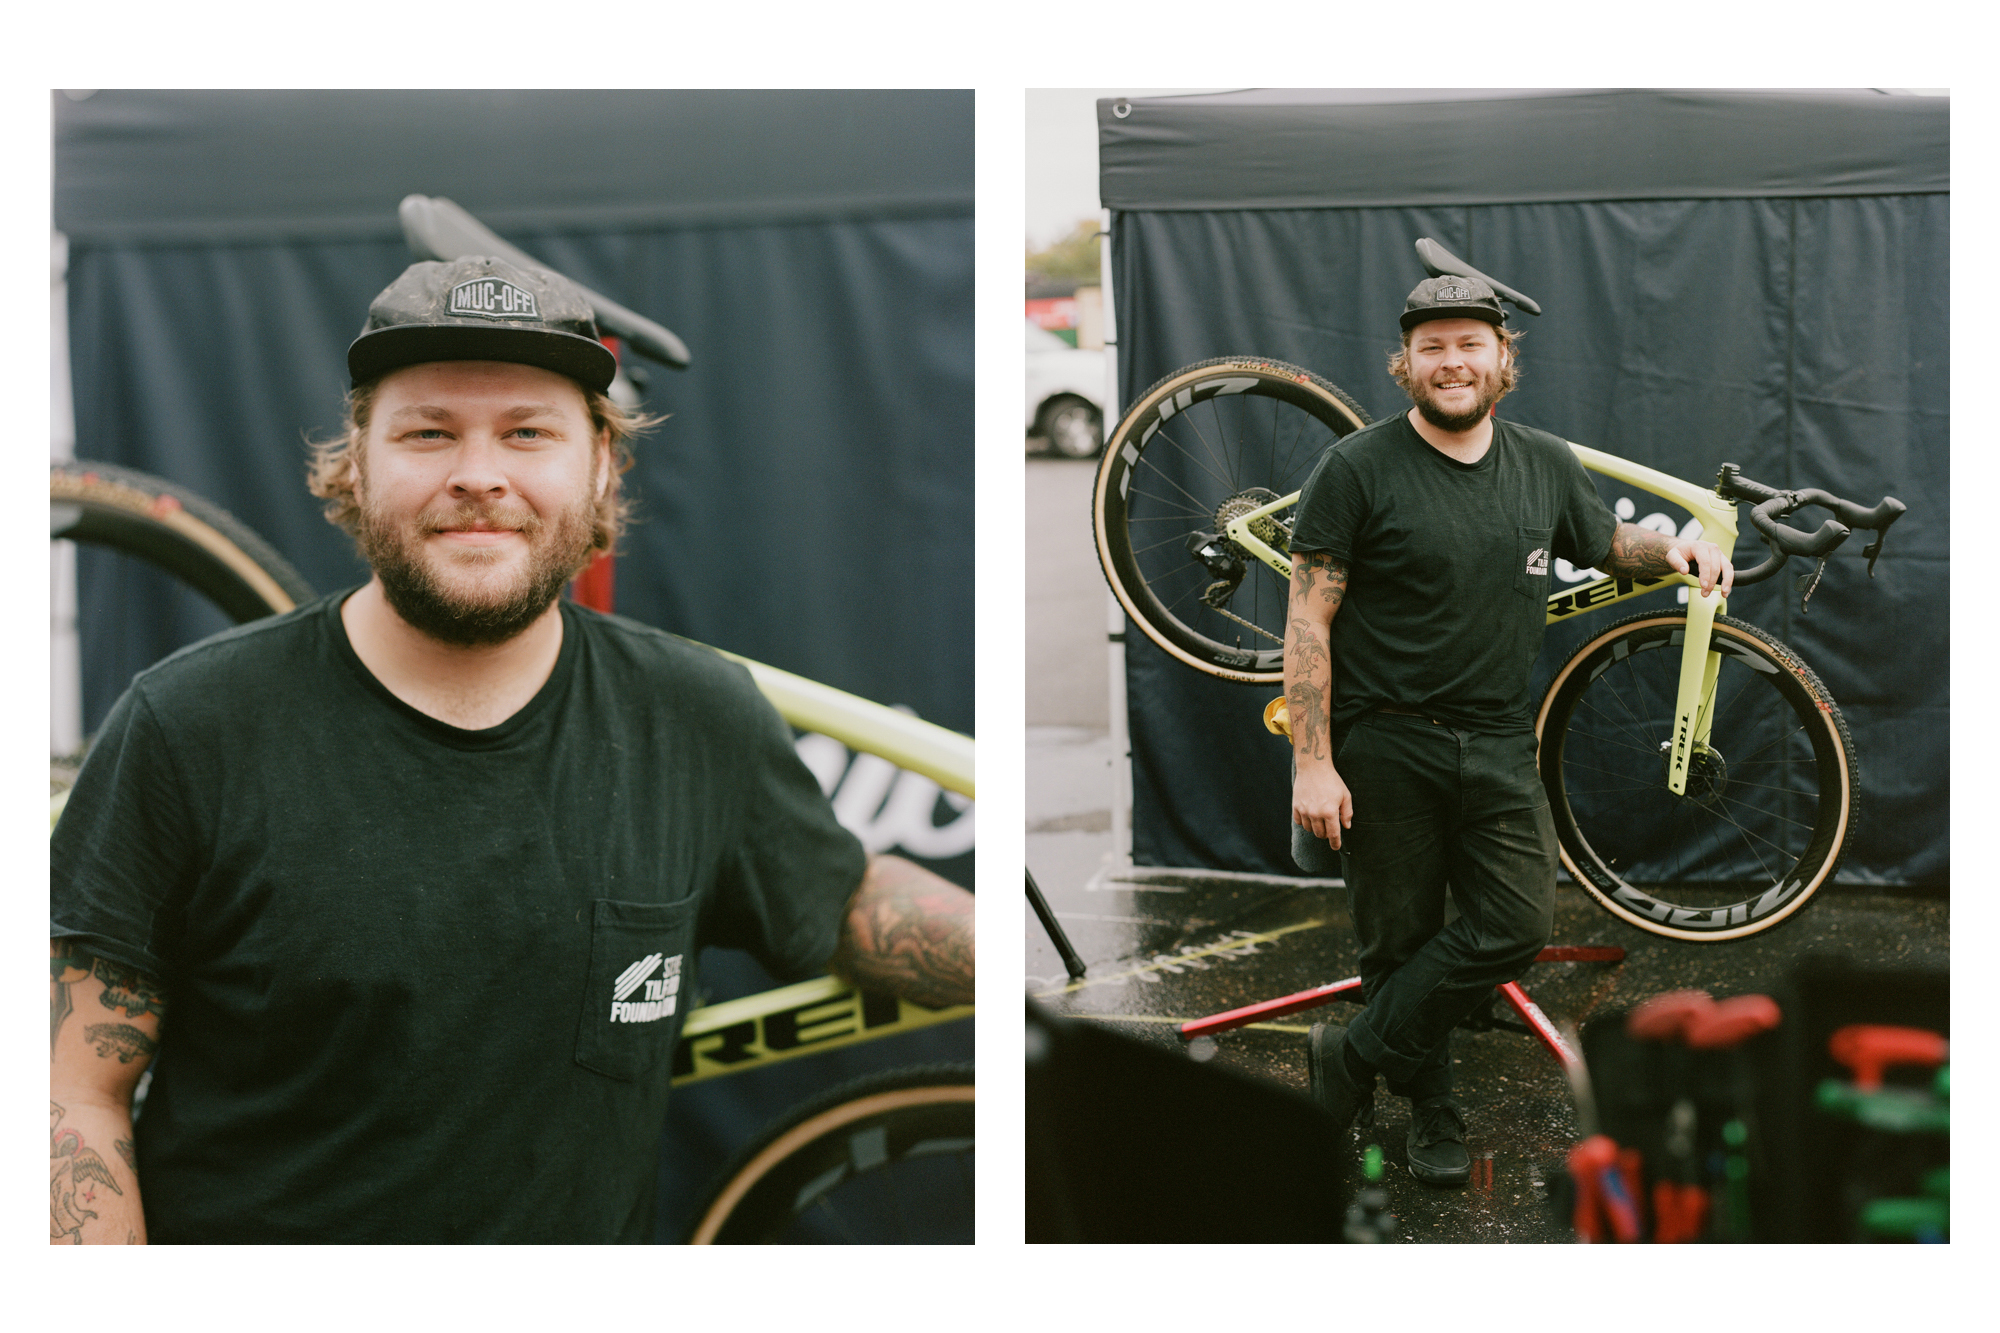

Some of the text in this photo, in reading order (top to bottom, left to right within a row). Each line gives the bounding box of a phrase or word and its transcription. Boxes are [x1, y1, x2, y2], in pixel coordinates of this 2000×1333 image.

[457, 282, 531, 312] MUC-OFF
[1440, 287, 1468, 298] MUC-OFF
[1260, 366, 1294, 380] EDITION
[1271, 560, 1292, 576] SR
[1772, 649, 1794, 669] TEAM
[1793, 670, 1819, 700] EDITION
[1675, 712, 1690, 772] TREK
